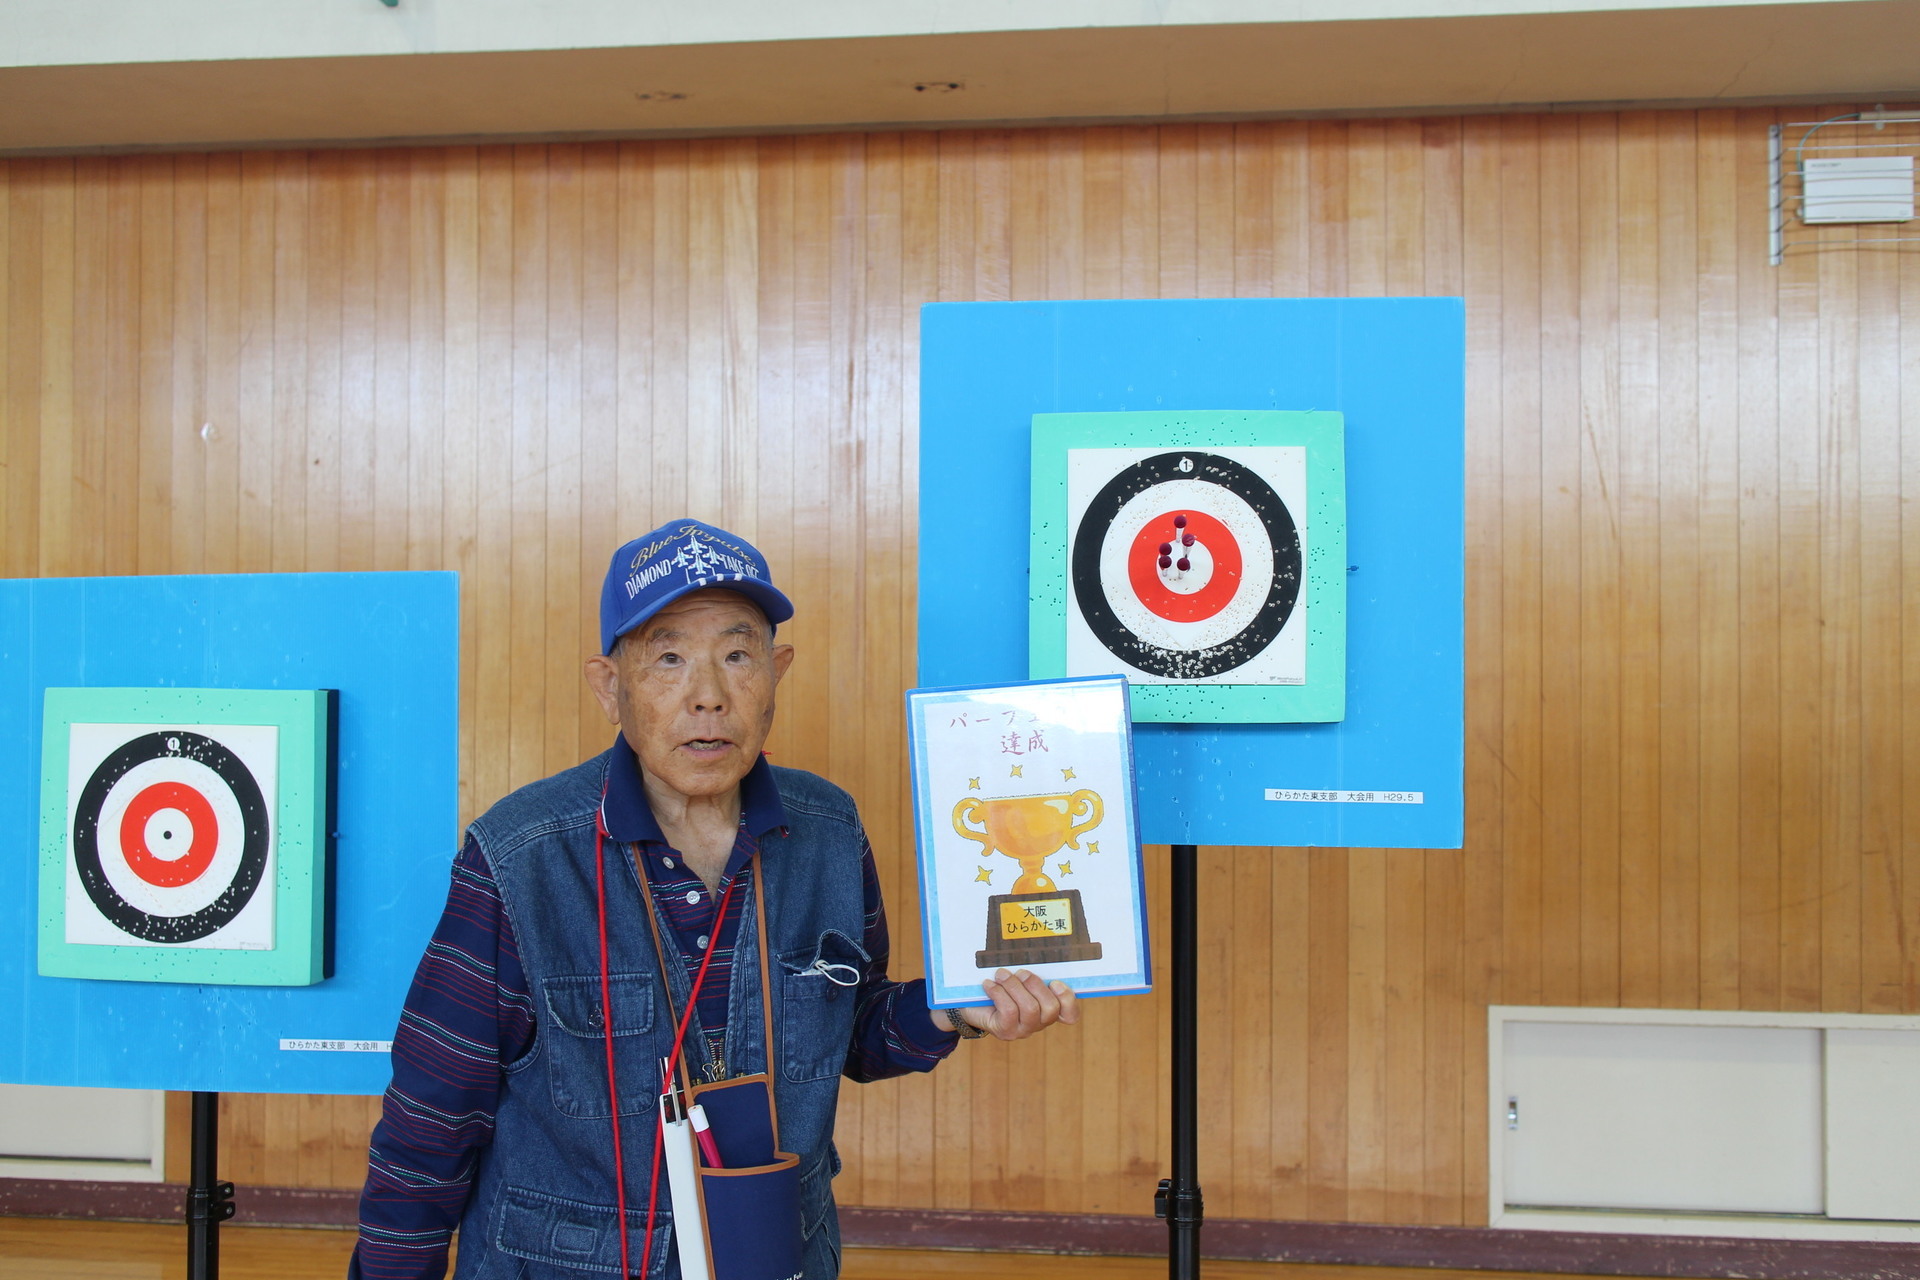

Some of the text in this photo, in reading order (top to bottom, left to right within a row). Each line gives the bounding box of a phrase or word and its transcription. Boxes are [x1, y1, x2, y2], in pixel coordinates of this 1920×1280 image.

[629, 525, 756, 577] Blue Impulse
[625, 559, 672, 600] DIAMOND
[719, 553, 745, 576] TAKE
[1000, 729, 1049, 756] 達成
[1275, 791, 1414, 802] ひらかた東支部 大会用 H29.5
[1024, 905, 1047, 918] 大阪
[1007, 919, 1067, 934] ひらかた東
[289, 1041, 346, 1050] ひらかた東支部
[353, 1042, 378, 1051] 大会用
